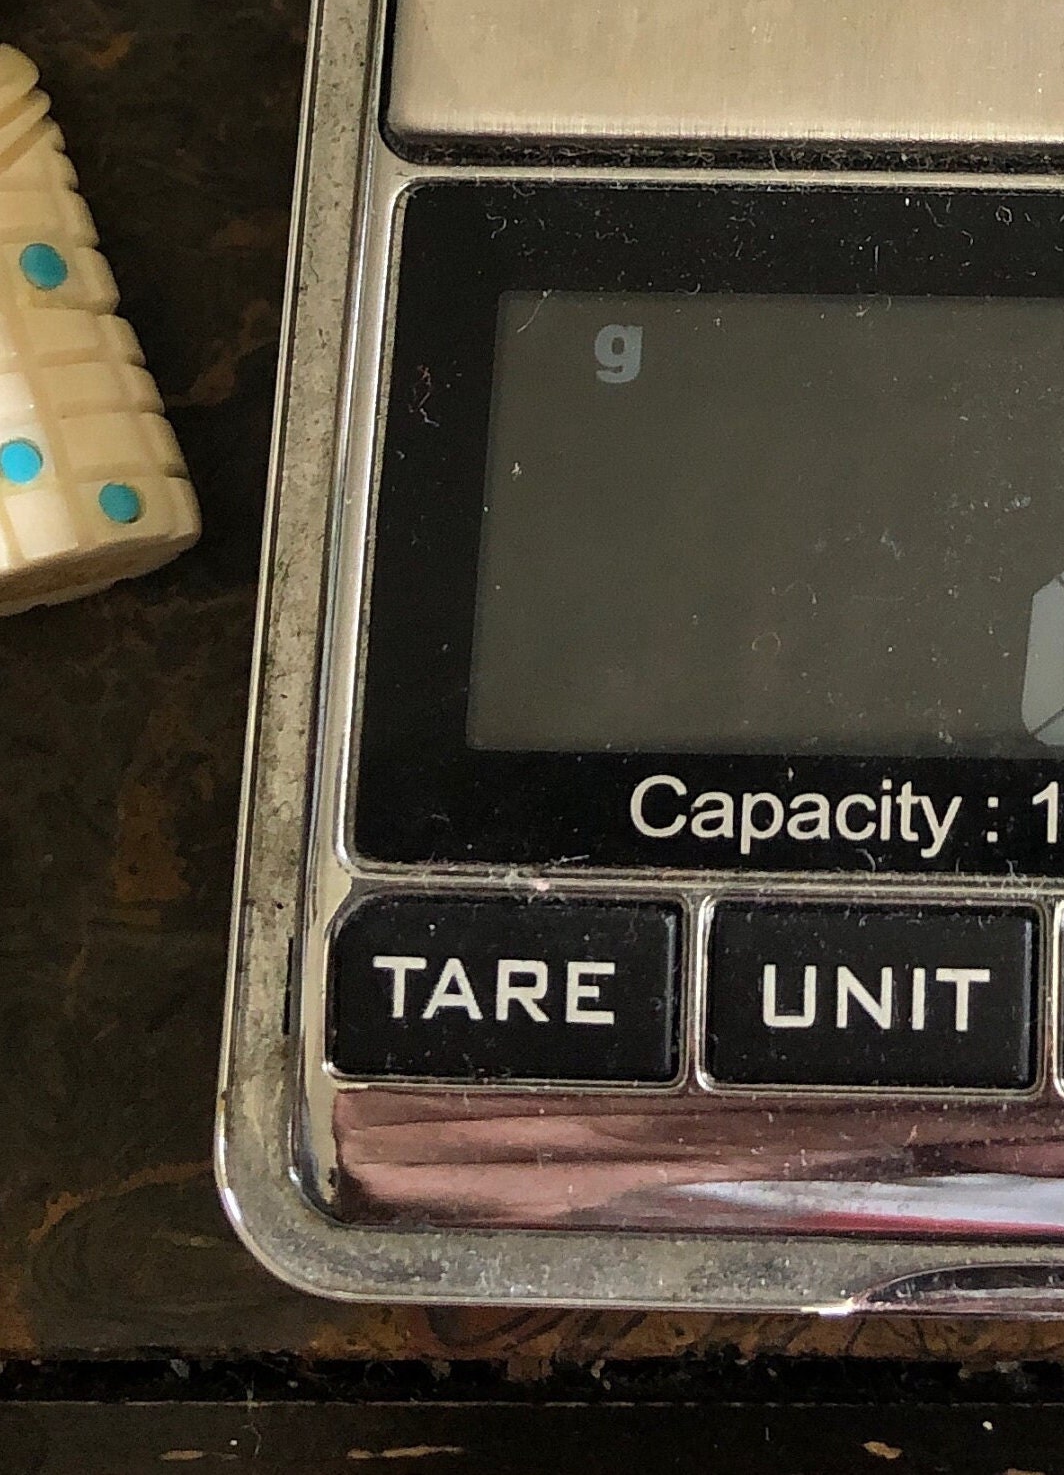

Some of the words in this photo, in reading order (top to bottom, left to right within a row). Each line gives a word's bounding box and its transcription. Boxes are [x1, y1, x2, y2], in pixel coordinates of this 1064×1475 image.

[593, 323, 644, 384] g
[628, 774, 961, 856] Capacity
[374, 956, 617, 1026] TARE
[761, 964, 991, 1034] UNIT
